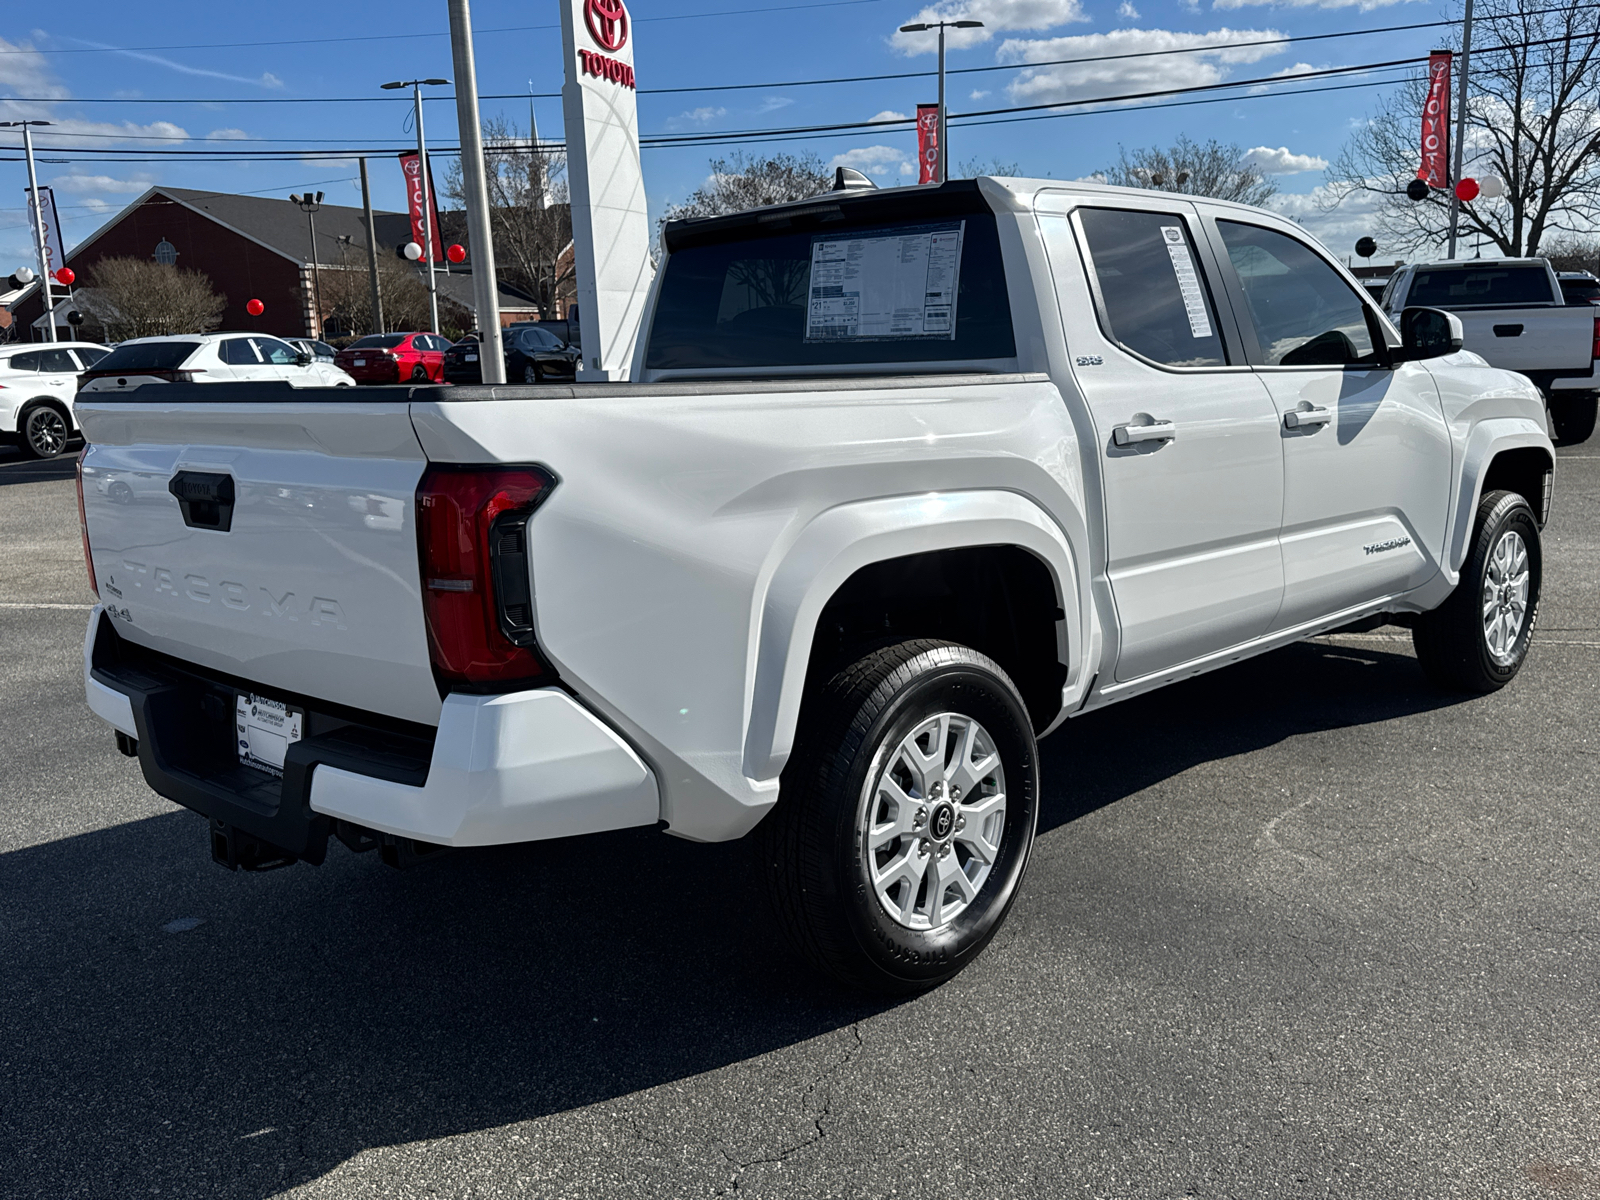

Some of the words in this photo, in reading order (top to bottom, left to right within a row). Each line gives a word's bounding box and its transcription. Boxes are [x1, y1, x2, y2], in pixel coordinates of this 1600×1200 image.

[577, 49, 636, 91] TOYOTA
[1425, 82, 1442, 182] TOYOTA
[925, 132, 938, 184] TOY
[1076, 355, 1104, 367] SR5
[183, 482, 212, 496] TOYOTA
[1363, 536, 1411, 556] TACOMA
[123, 559, 348, 631] TACOMA
[255, 695, 287, 711] HUTCHINSON
[870, 916, 948, 966] Firestone
